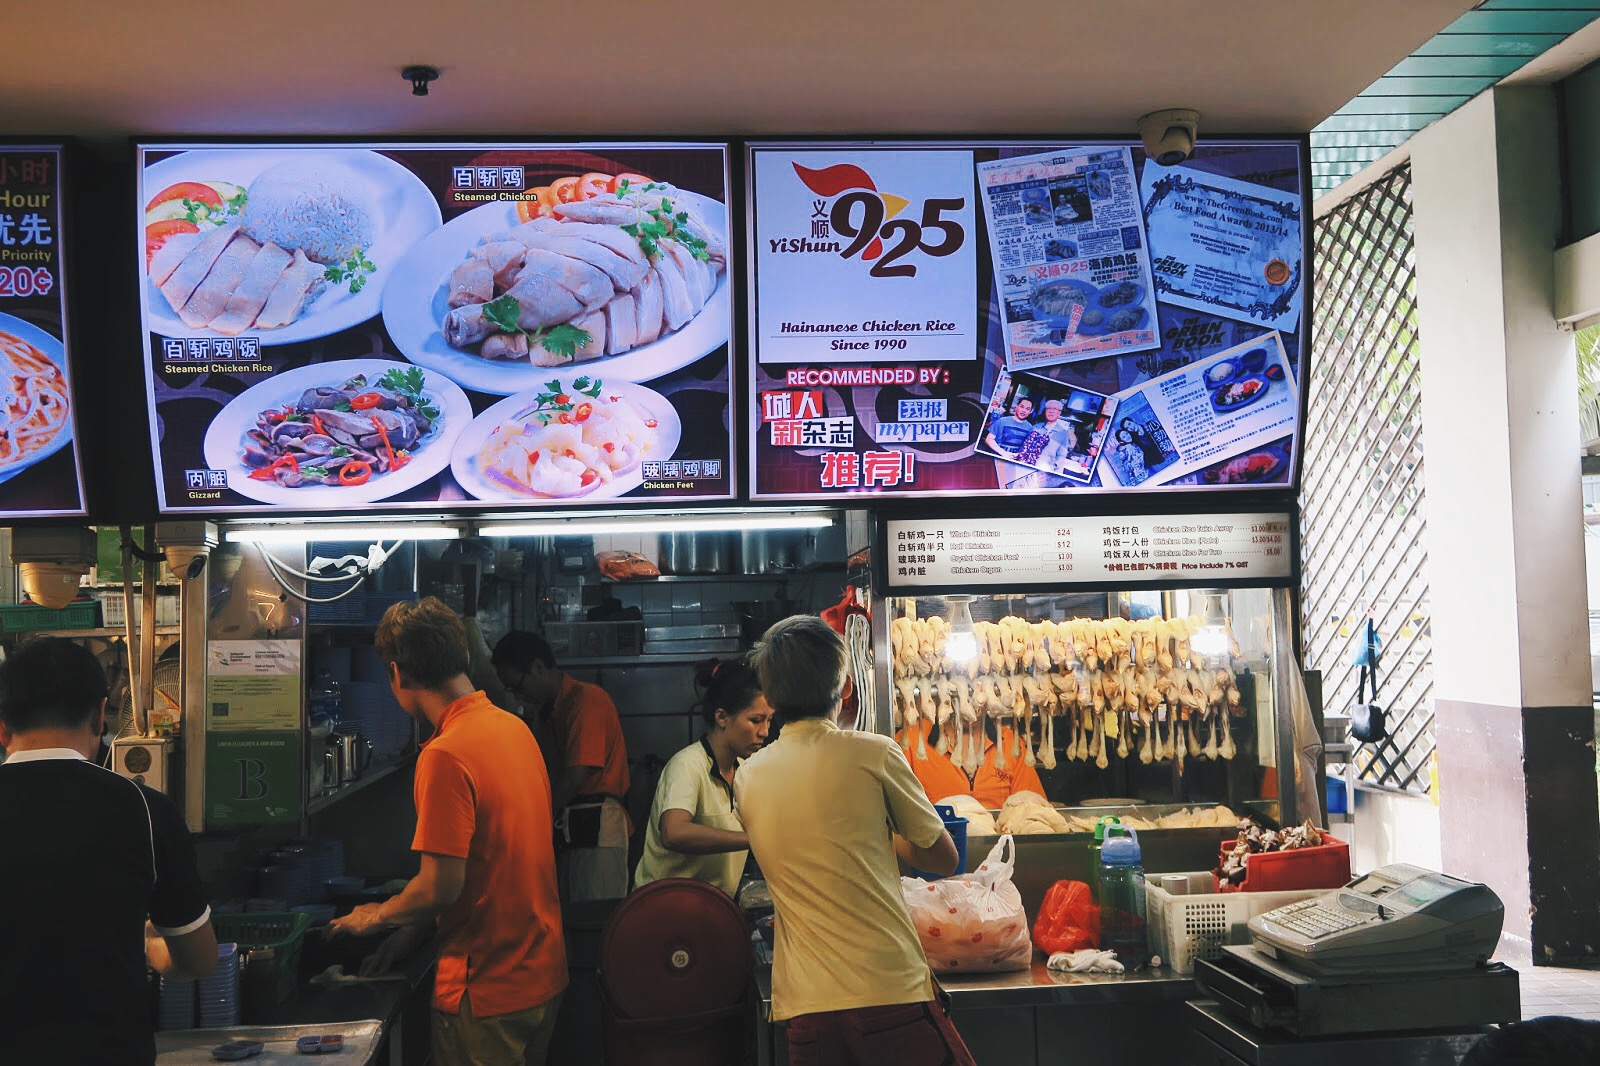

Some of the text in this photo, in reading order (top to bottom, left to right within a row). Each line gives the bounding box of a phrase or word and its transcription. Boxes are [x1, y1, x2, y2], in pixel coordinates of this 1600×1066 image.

[456, 168, 522, 188] 白斩鸡
[454, 192, 537, 201] Steamed Chicken
[1184, 193, 1283, 224] www.TheGreenBook.com
[811, 198, 830, 239] 义顺
[1174, 201, 1289, 237] Best Food Awards 2013/14
[829, 191, 965, 278] 925
[769, 238, 842, 253] YiShun
[2, 249, 52, 262] Priority
[1153, 257, 1188, 271] GREEN
[1155, 265, 1188, 277] BOOK
[780, 320, 956, 333] Hainanese Chicken Rice
[1165, 320, 1224, 339] GREEN
[830, 338, 907, 350] Since 1990
[1171, 331, 1226, 351] BOOK
[164, 339, 259, 360] 白斩鸡饭
[165, 363, 273, 374] Steamed Chicken Rice
[787, 370, 915, 385] RECOMMENDED
[919, 369, 940, 384] BY
[763, 391, 822, 420] 城人
[773, 419, 853, 447] 新杂志
[878, 422, 969, 442] mypaper
[643, 461, 719, 478] 玻璃鸡脚
[820, 450, 915, 487] 推荐!
[189, 471, 226, 487] 内脏
[643, 481, 694, 490] Chicken Feet
[188, 491, 221, 499] Gizzard
[897, 530, 944, 540] 白斩鸡一只
[971, 530, 1000, 538] Chicken
[1102, 526, 1140, 535] 鸡饭打包
[1153, 525, 1234, 534] Chicken Rice Take Away
[898, 542, 945, 552] 白斩鸡半只
[964, 542, 993, 550] Chicken
[1103, 538, 1149, 548] 鸡饭一人份
[1153, 538, 1181, 546] Chicken
[1182, 537, 1196, 545] Rice
[897, 554, 936, 564] 玻璃鸡脚
[950, 553, 1020, 563] Crystal Chicken Feet
[1103, 550, 1149, 559] 鸡饭双人份
[1153, 550, 1182, 558] Chicken
[1182, 549, 1197, 557] Rice
[898, 566, 927, 576] 鸡内脏
[950, 566, 1003, 575] Chicken Organ
[1181, 562, 1198, 570] Price
[232, 758, 269, 801] B
